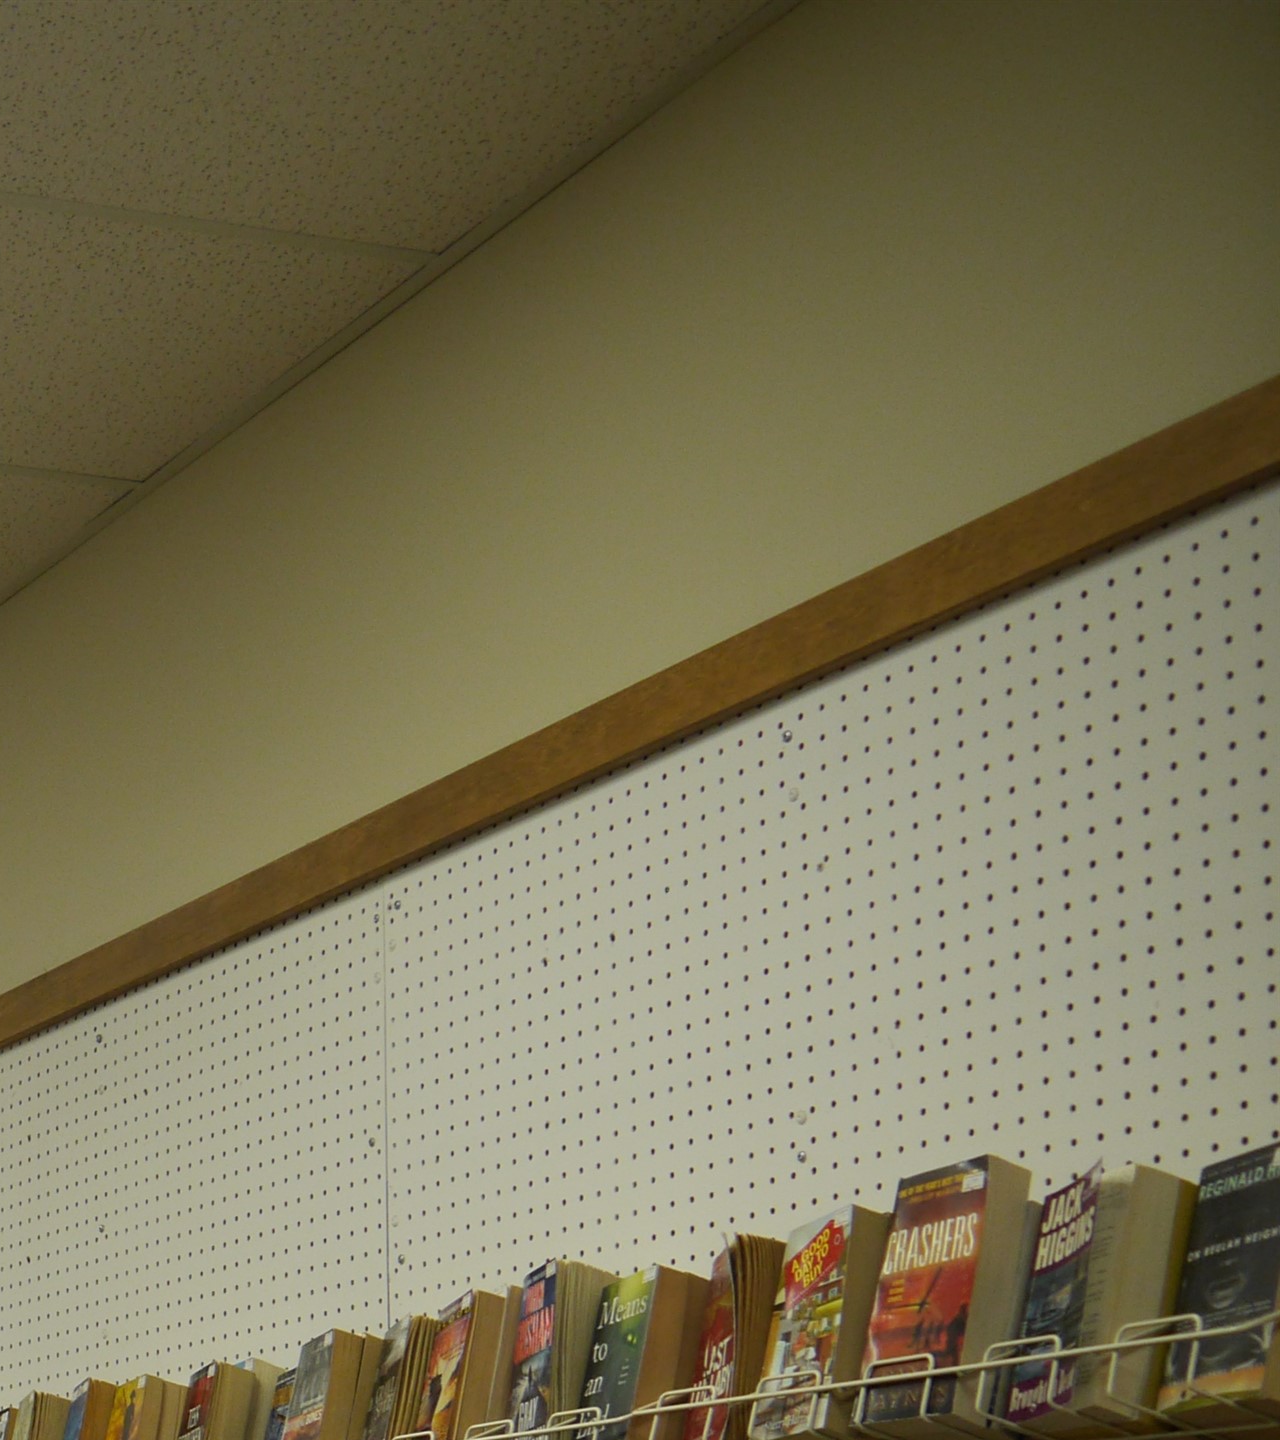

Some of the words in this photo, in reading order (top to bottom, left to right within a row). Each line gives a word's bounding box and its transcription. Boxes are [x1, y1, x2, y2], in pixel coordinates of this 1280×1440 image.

[1200, 1161, 1264, 1201] REGINALD
[1042, 1180, 1085, 1233] JACK
[882, 1212, 978, 1275] CRASHERS
[1035, 1206, 1096, 1272] HIGGINS
[597, 1295, 647, 1330] Means
[593, 1342, 609, 1364] to
[584, 1375, 604, 1397] an
